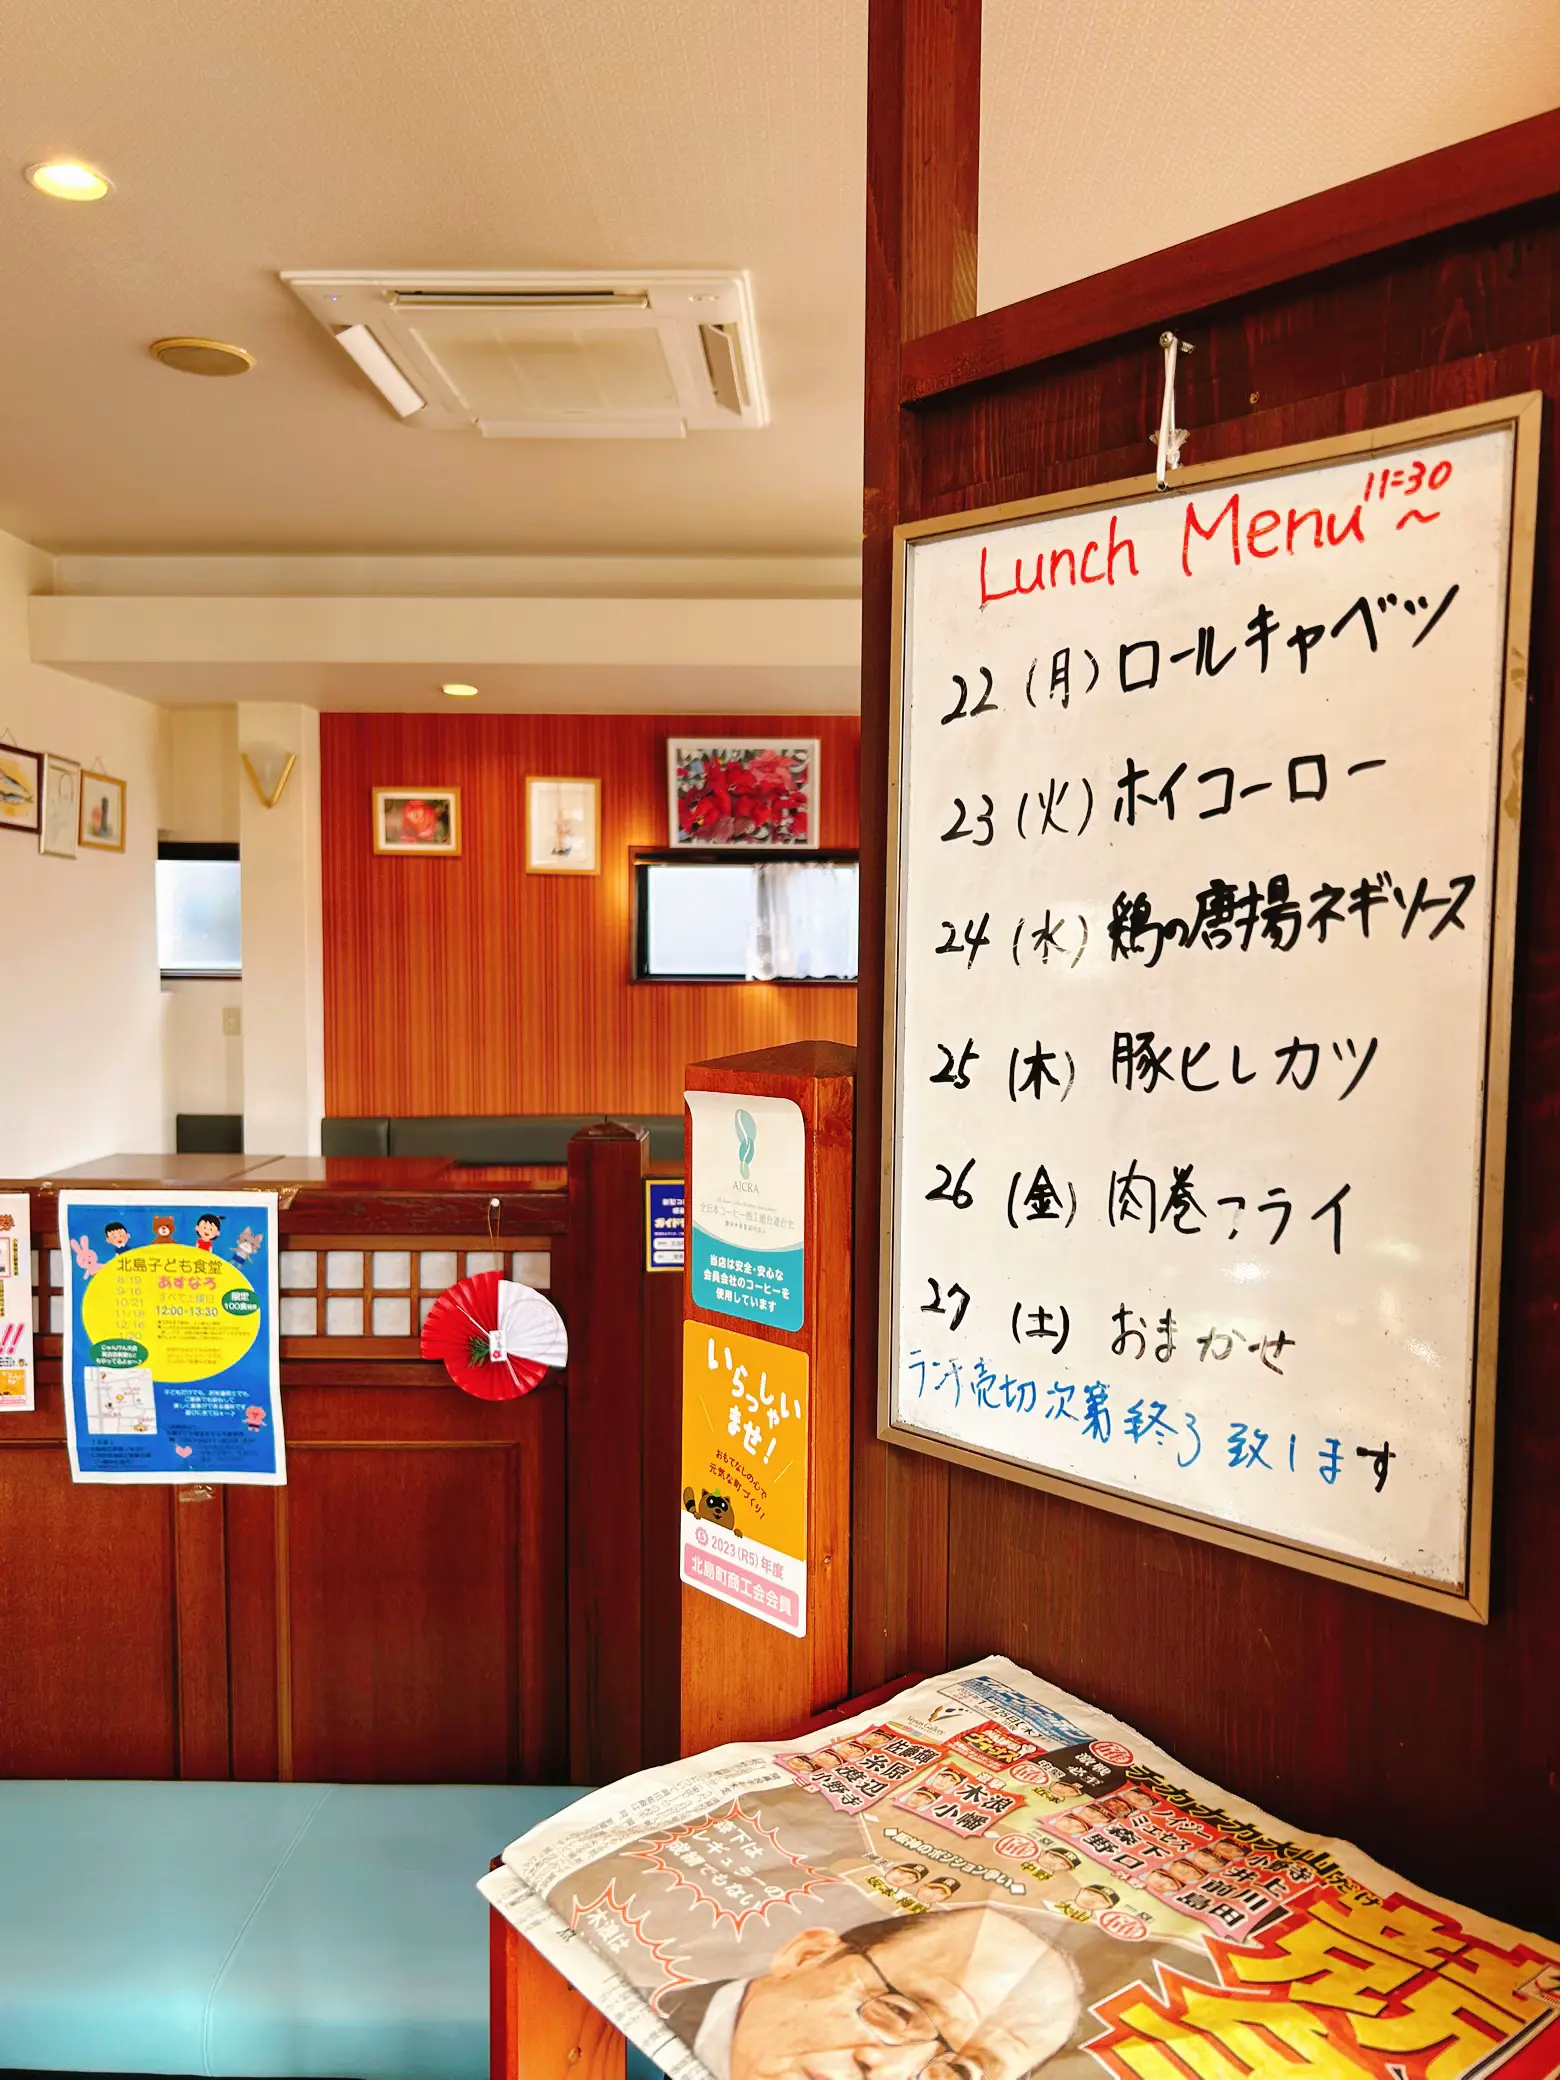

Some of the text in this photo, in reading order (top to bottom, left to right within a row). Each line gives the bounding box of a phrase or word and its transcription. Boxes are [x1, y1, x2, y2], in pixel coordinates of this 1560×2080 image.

[979, 494, 1364, 603] Lunch Menu
[941, 668, 998, 725] 22
[1118, 584, 1460, 693] ロールキャベツ
[940, 794, 994, 846] 23
[1114, 754, 1387, 826] ホイコーロー
[935, 912, 990, 970] 24
[929, 1038, 979, 1090] 25
[1111, 1031, 1378, 1101] 豚ヒレカツ
[733, 1181, 760, 1194] AJCRA
[925, 1158, 976, 1210] 26
[117, 1258, 223, 1275] 北島子ども食堂
[158, 1276, 217, 1290] あすなろ
[710, 1254, 784, 1281] 当店は安全・安心な
[703, 1269, 790, 1300] 会員会社のコーヒーを
[716, 1287, 776, 1312] 使用しています
[920, 1277, 971, 1330] 27
[1111, 1302, 1296, 1375] おまかせ
[716, 1449, 768, 1500] おもてなしの心で
[691, 1552, 792, 1616] 北島町商工会会員
[859, 1754, 915, 1780] 糸原
[884, 1740, 940, 1764] 佐藤輝
[810, 1772, 863, 1807] 小野寺
[836, 1765, 891, 1798] 渡辺
[956, 1783, 1014, 1812] 木浪
[933, 1803, 990, 1832] 小幡
[1131, 1814, 1195, 1852] ミエセス
[1151, 1807, 1213, 1841] ノイジー
[714, 1819, 763, 1858] 森下は
[1083, 1833, 1146, 1870] 野口
[1106, 1822, 1172, 1859] 森下
[1020, 1861, 1053, 1881] 中野
[1221, 1867, 1290, 1898] 井上
[1246, 1853, 1316, 1889] 小野寺
[1054, 1900, 1092, 1922] 大山
[1176, 1892, 1247, 1928] 島田
[1200, 1878, 1269, 1911] 前川
